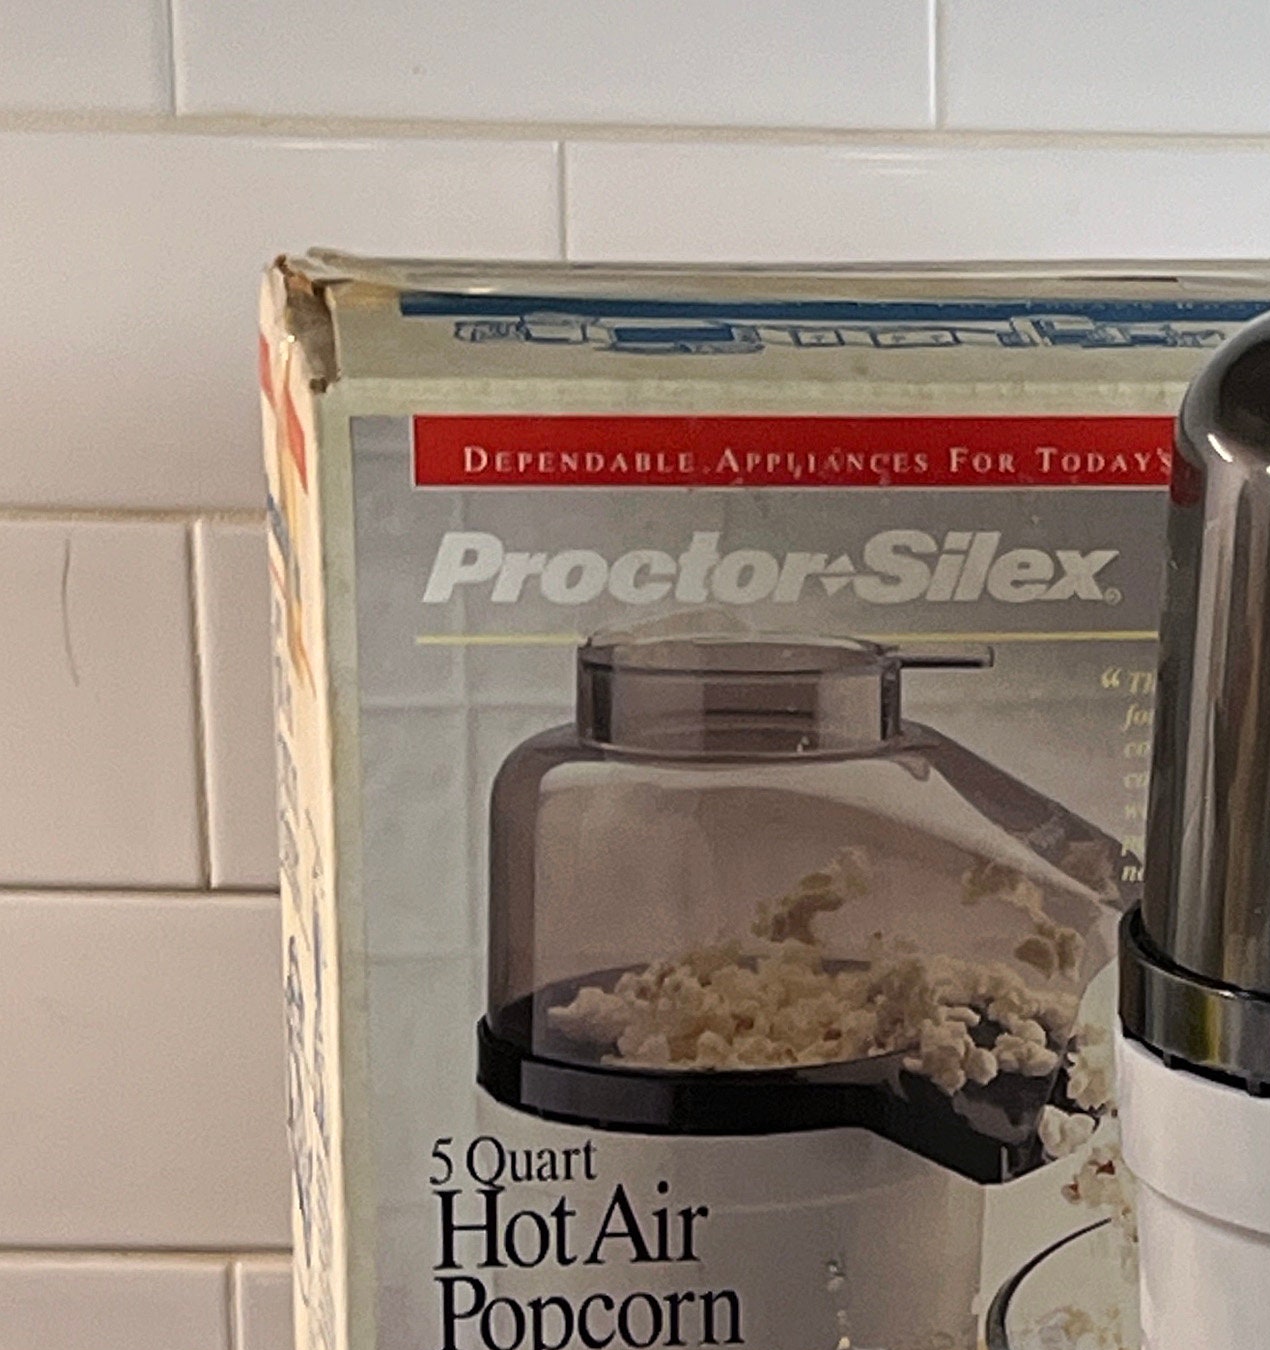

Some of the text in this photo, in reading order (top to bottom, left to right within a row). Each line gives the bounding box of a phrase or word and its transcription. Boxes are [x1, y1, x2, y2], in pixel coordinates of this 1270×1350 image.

[429, 1136, 598, 1188] 5 Quart
[432, 1181, 709, 1270] Hot Air
